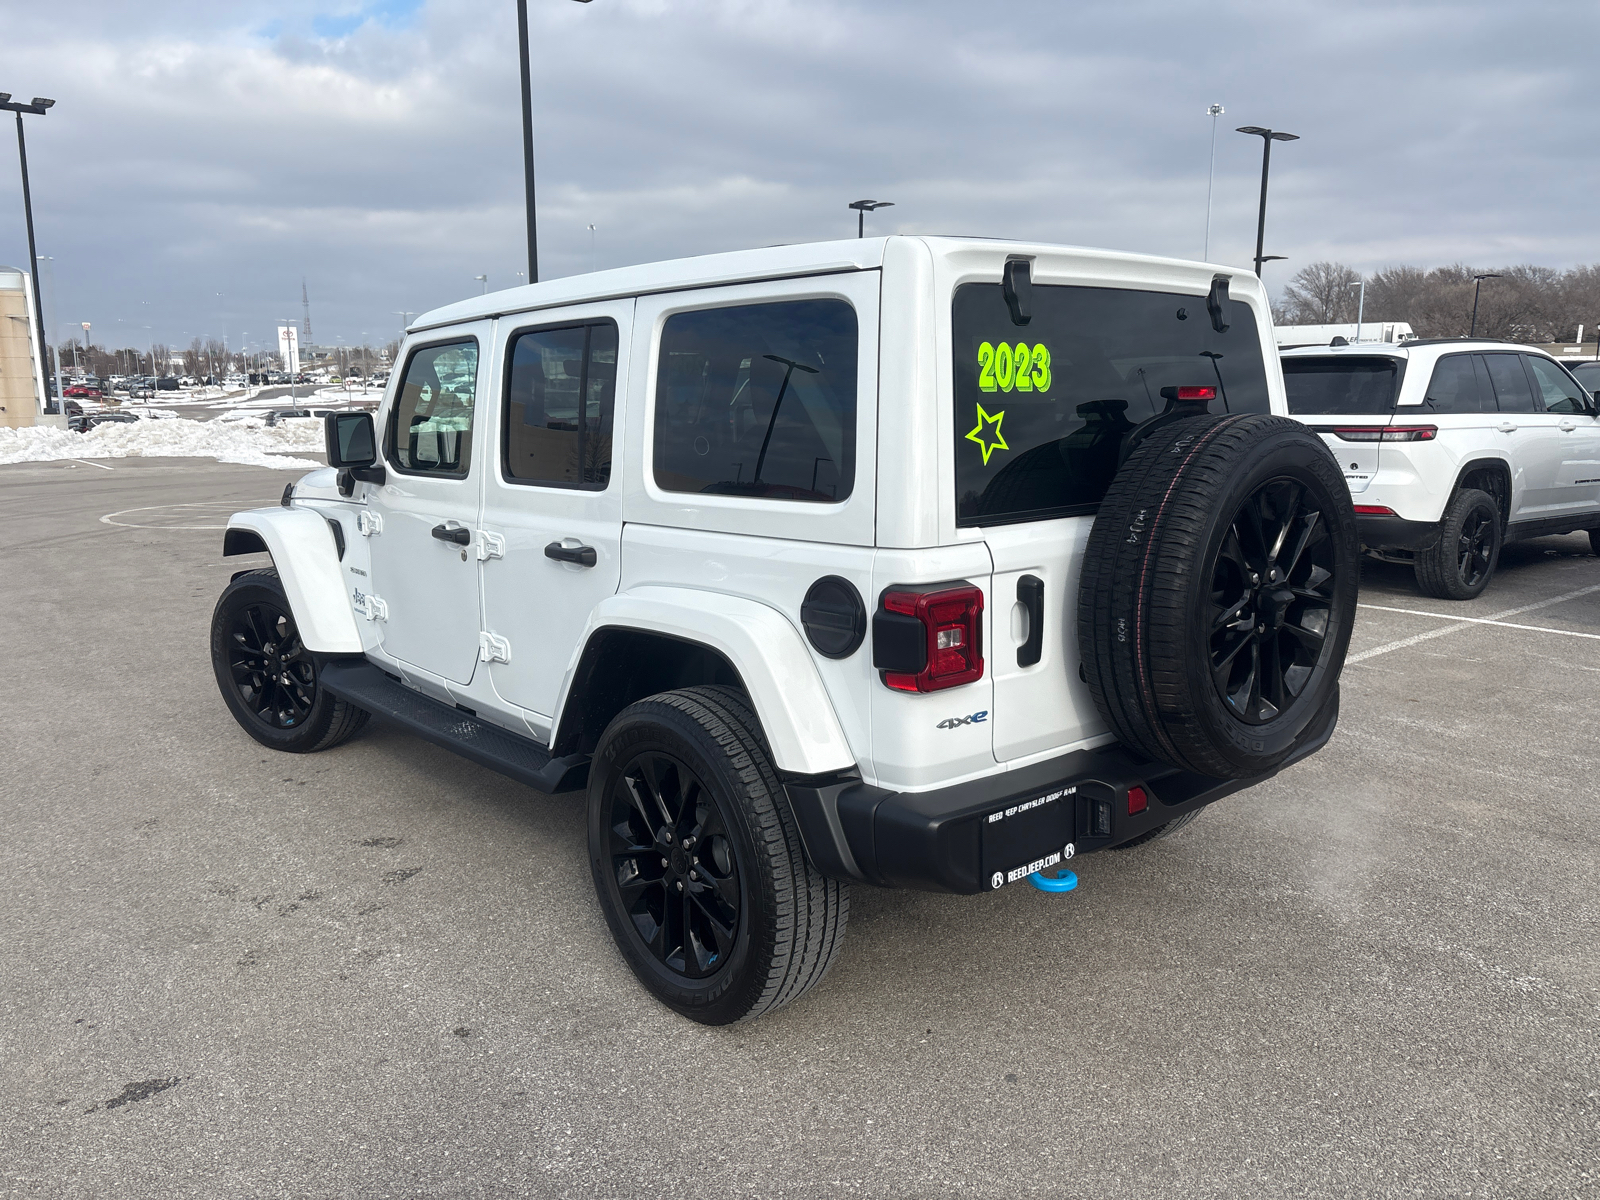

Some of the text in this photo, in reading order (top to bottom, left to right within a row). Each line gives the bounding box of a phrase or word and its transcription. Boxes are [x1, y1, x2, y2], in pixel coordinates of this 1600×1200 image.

[977, 341, 1052, 393] 2023
[936, 710, 989, 730] 4xe
[988, 786, 1077, 823] REED JEEP CHRYSLER DODGE RAM
[1007, 852, 1061, 883] REEDJEEP.COM
